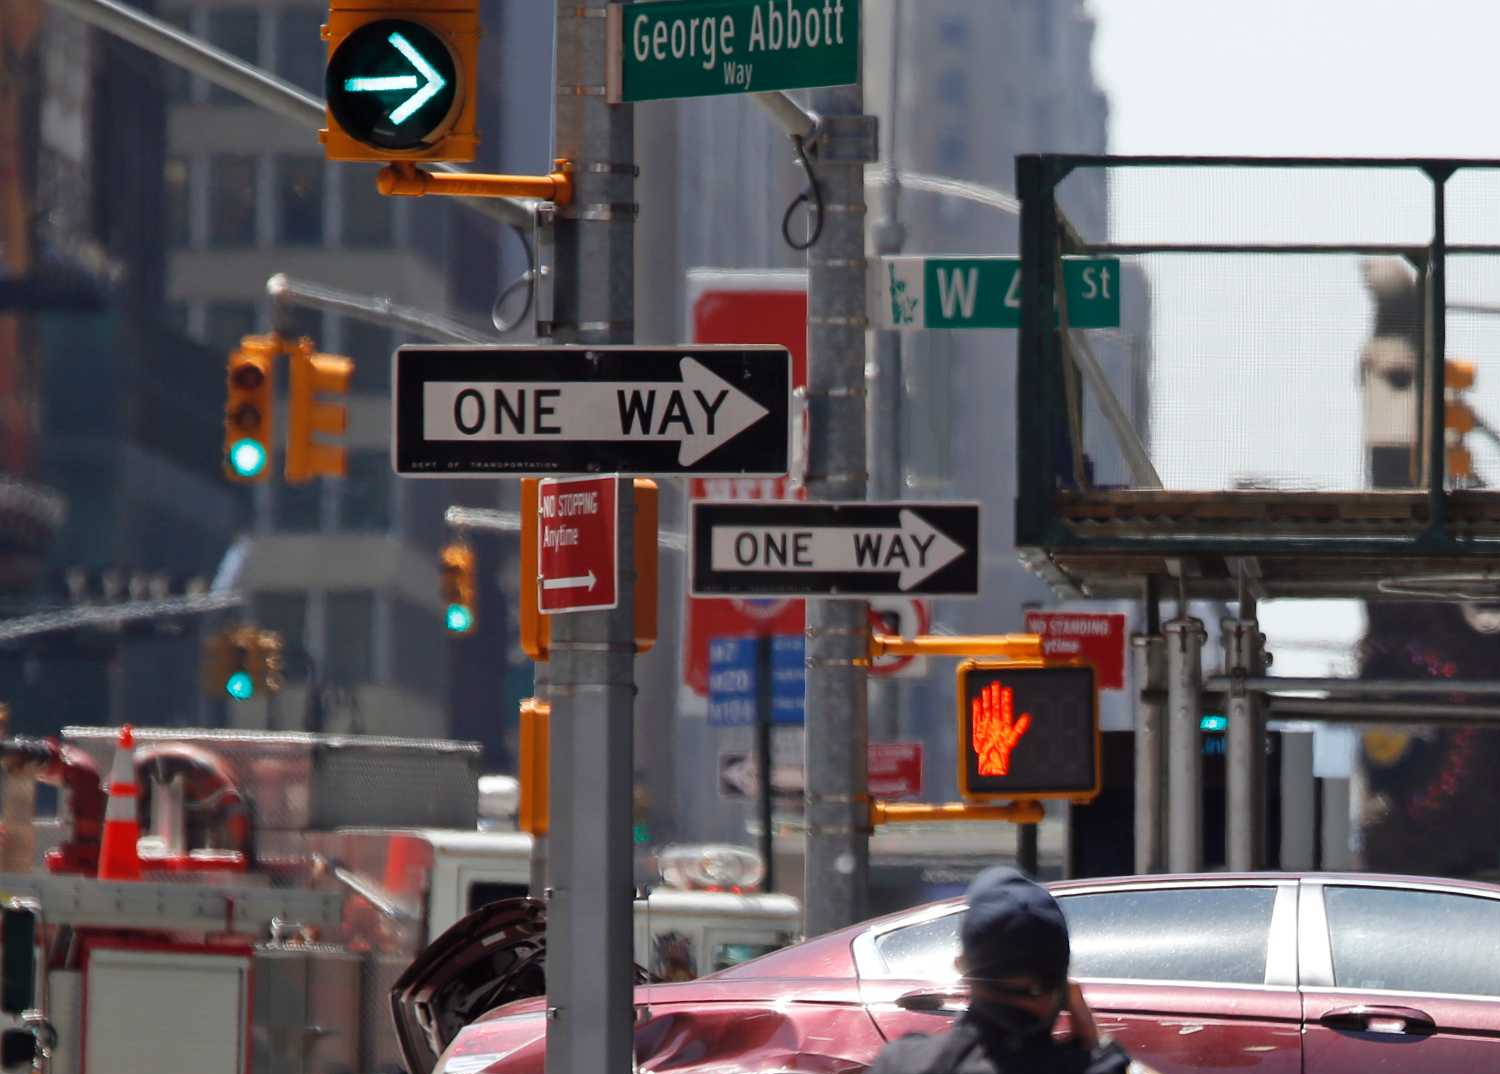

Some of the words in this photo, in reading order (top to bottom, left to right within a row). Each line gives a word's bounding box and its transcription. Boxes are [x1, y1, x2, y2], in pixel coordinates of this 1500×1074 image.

[633, 14, 735, 70] George
[749, 0, 845, 51] Abbott
[723, 61, 753, 90] Way
[936, 267, 979, 319] W
[1082, 266, 1111, 299] St
[453, 389, 562, 436] ONE
[617, 389, 728, 437] WAY
[543, 495, 556, 517] NO
[558, 492, 598, 517] STOPPING
[543, 525, 579, 552] Anytime
[734, 531, 813, 567] ONE
[853, 533, 936, 568] WAY
